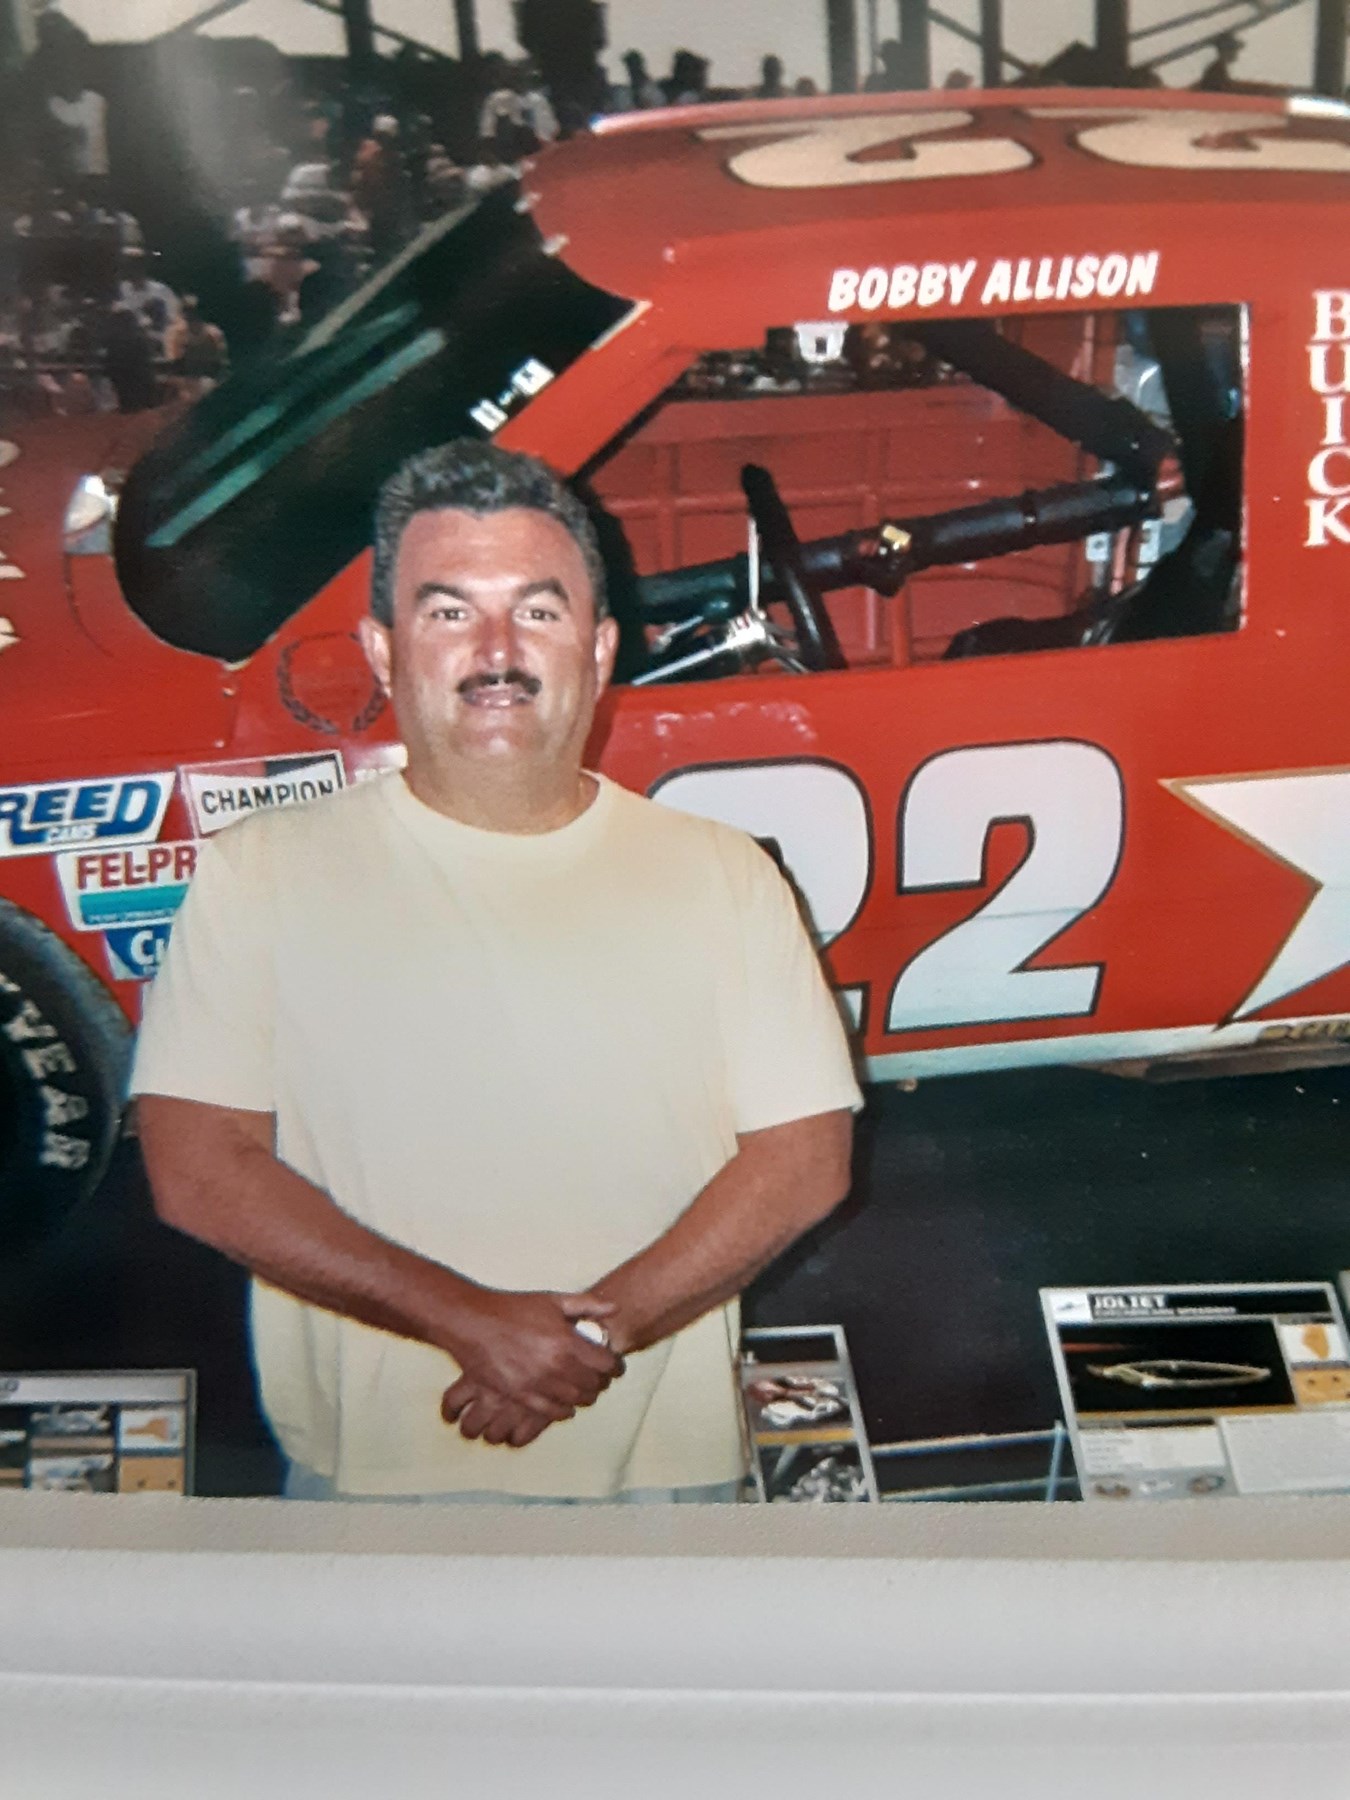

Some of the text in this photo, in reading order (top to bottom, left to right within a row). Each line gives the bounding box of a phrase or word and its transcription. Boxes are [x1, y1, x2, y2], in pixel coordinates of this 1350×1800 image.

[827, 250, 1160, 312] BOBBY ALLISON
[1303, 287, 1350, 548] BUICK
[0, 780, 162, 845] REED
[201, 779, 334, 815] CHAMPION
[76, 846, 197, 890] FEL-PR
[1094, 1295, 1167, 1308] JOLIET
